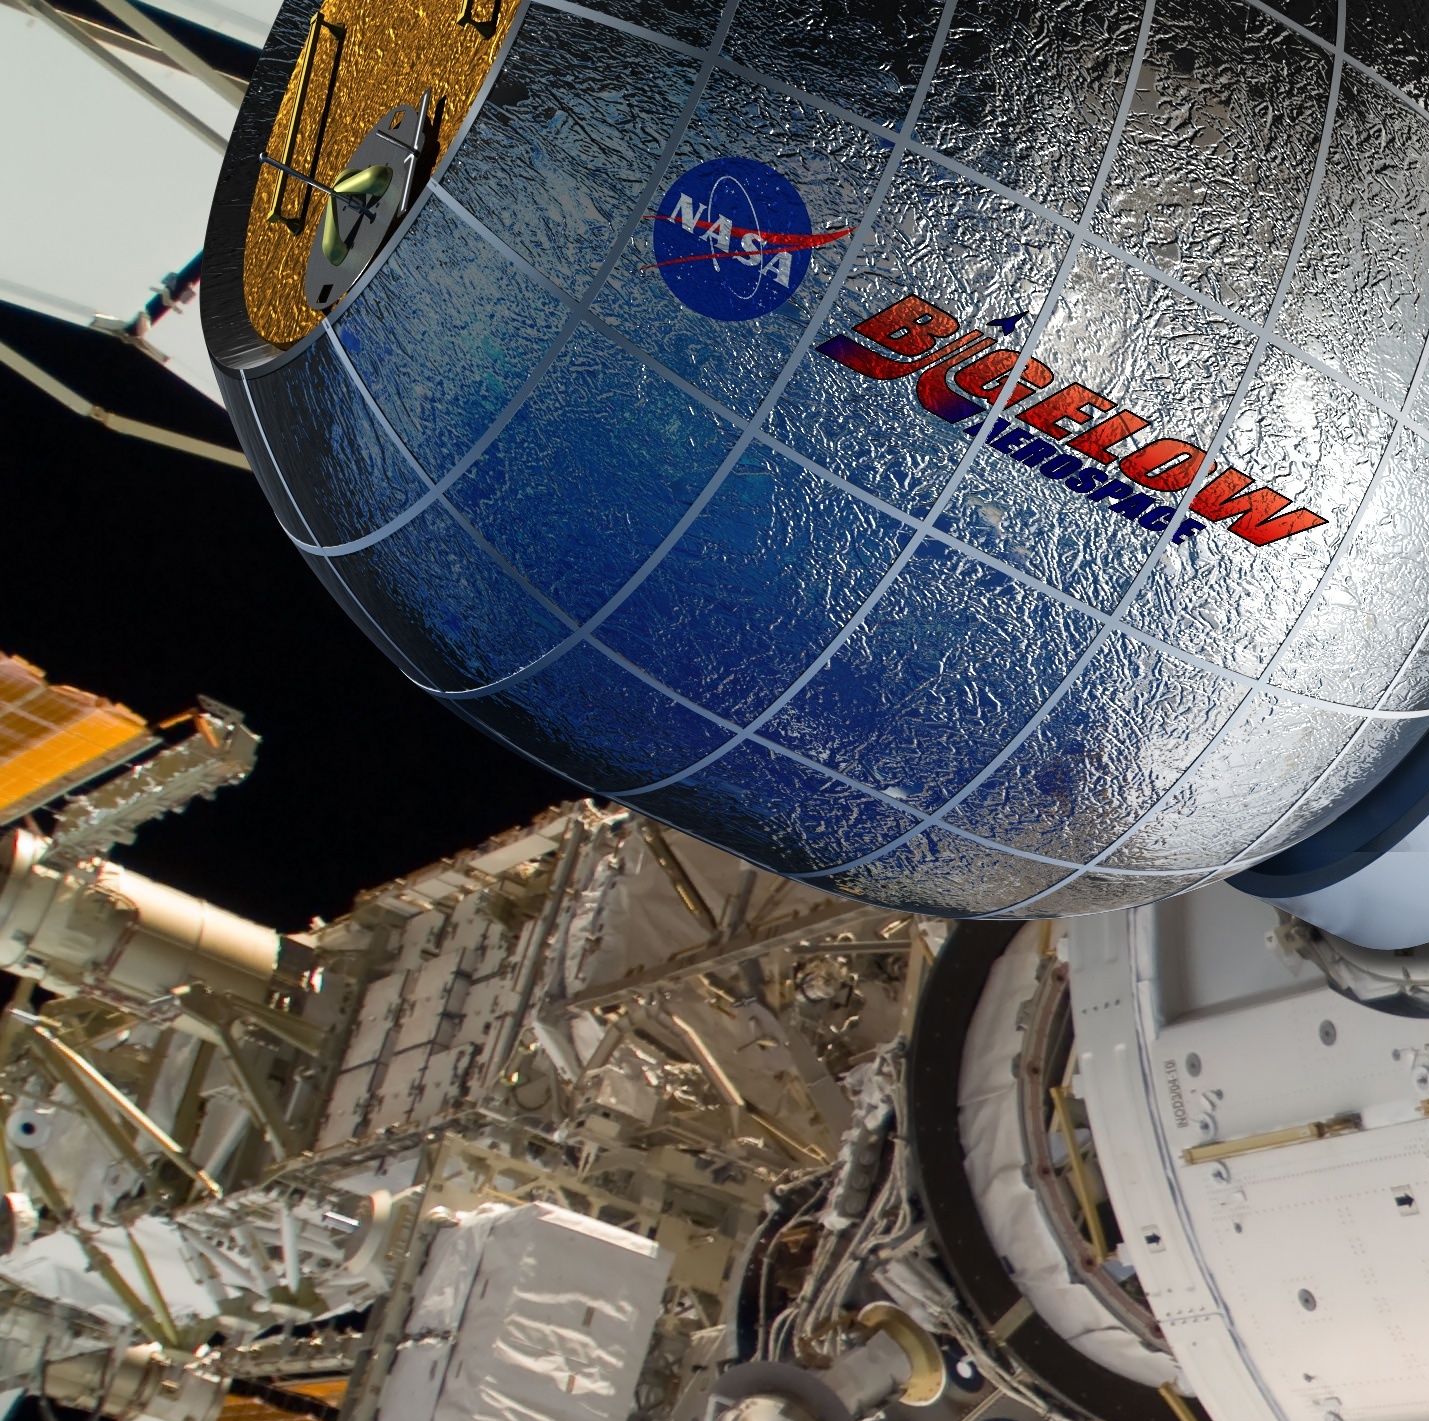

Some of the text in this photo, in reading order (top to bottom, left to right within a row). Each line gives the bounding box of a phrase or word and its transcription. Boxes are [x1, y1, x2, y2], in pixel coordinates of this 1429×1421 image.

[667, 192, 793, 288] NASA
[816, 294, 1329, 547] BIGELOW
[963, 418, 1207, 545] AEROSPACE
